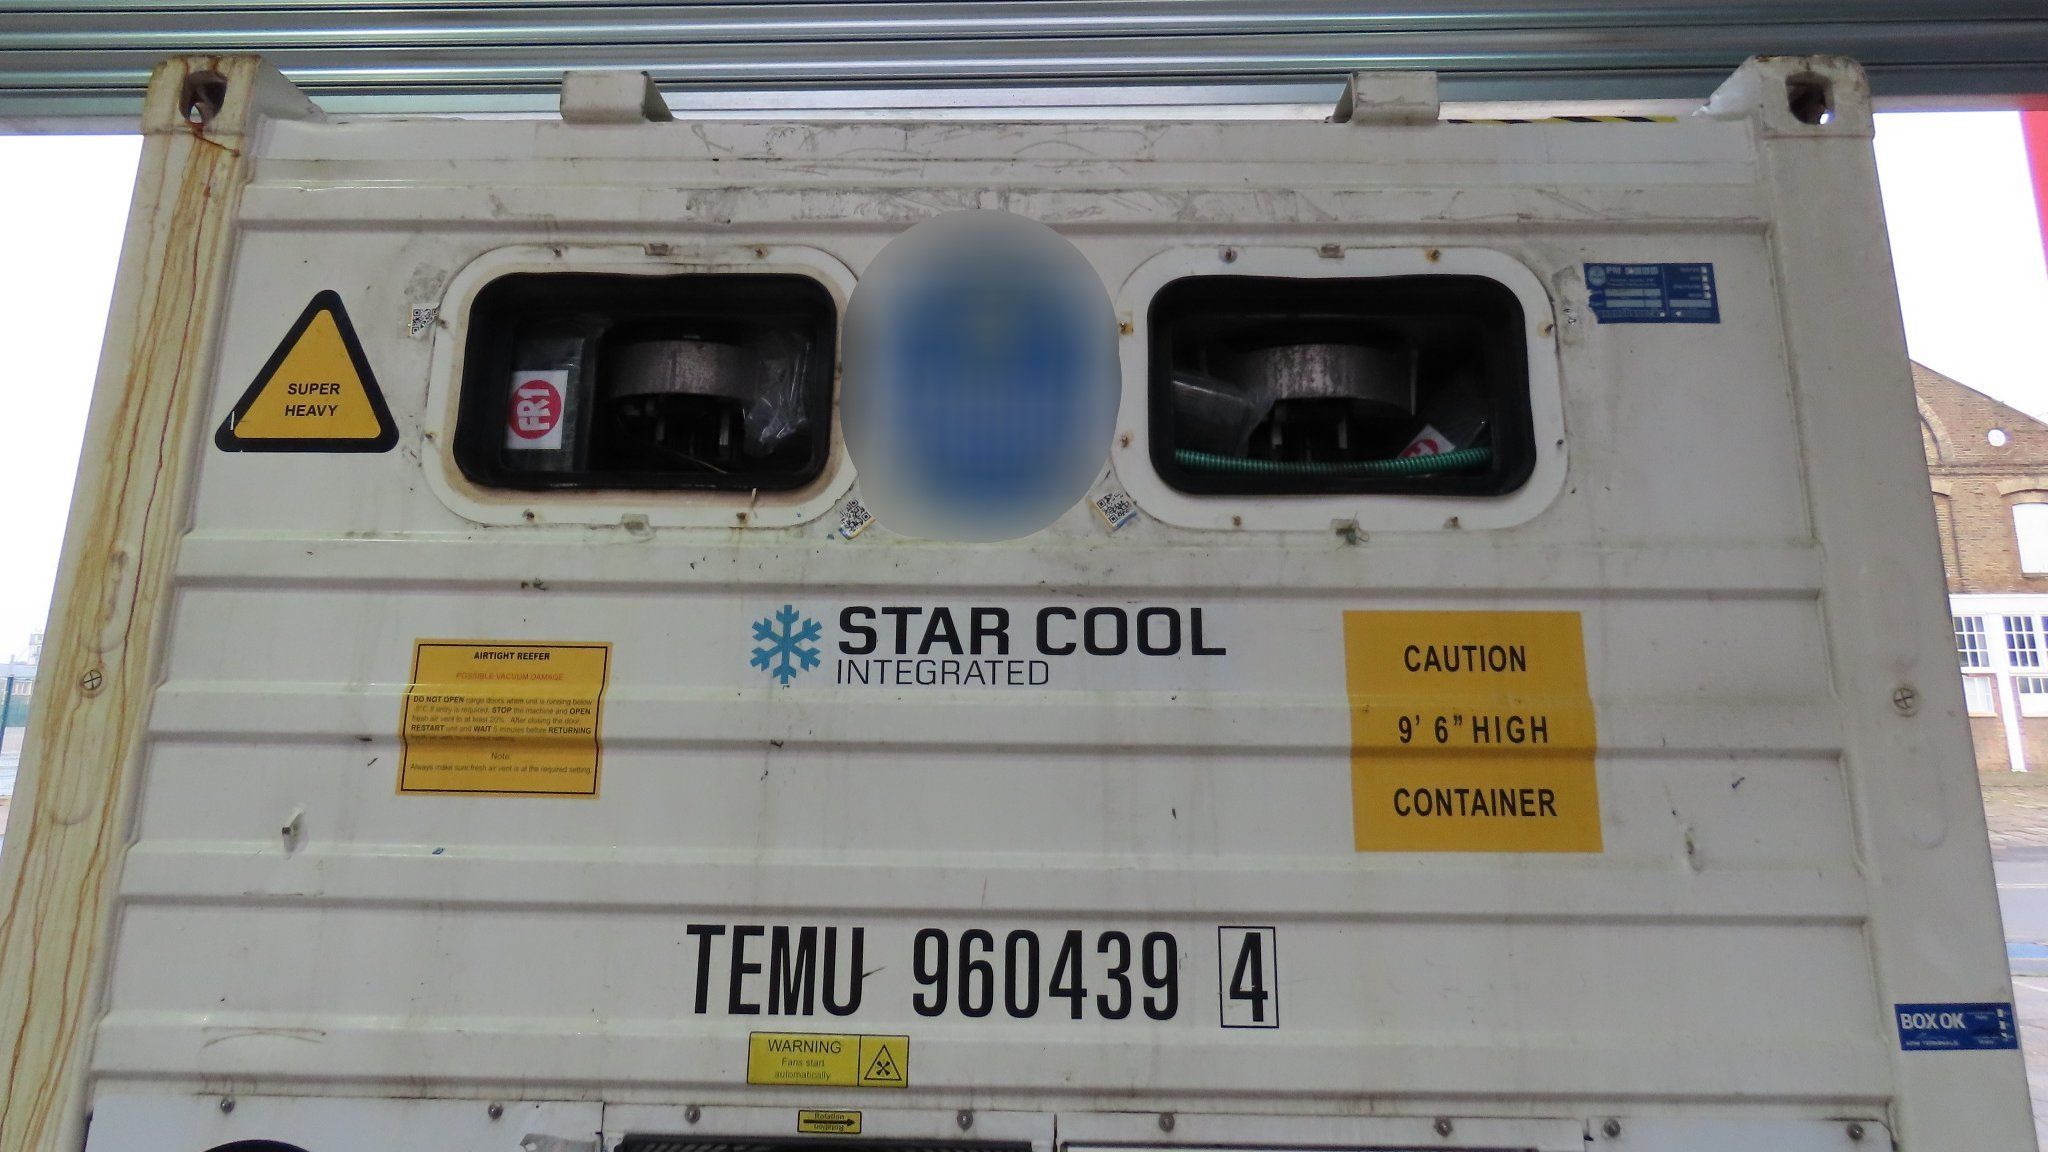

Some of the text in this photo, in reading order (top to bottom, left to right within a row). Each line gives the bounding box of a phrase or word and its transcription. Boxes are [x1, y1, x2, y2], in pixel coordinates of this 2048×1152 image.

[287, 383, 340, 395] SUPER
[284, 405, 338, 417] HEAVY
[838, 605, 1227, 657] STAR COOL
[473, 652, 550, 660] AIRTIGHT REEFER
[1403, 645, 1527, 672] CAUTION
[496, 672, 529, 680] VACUUM
[530, 673, 563, 681] DAMAGE
[836, 659, 1049, 686] INTEGRATED
[411, 724, 445, 732] RESTART
[548, 727, 592, 735] RETURNING
[1472, 716, 1548, 744] HIGH
[1393, 788, 1557, 817] CONTAINER
[686, 924, 1268, 1022] TEMU 960439 4
[1900, 1013, 1939, 1029] BOX
[1939, 1012, 1966, 1029] OK
[768, 1039, 842, 1054] WARNING
[781, 1058, 825, 1067] Fans start
[774, 1070, 831, 1080] automatically
